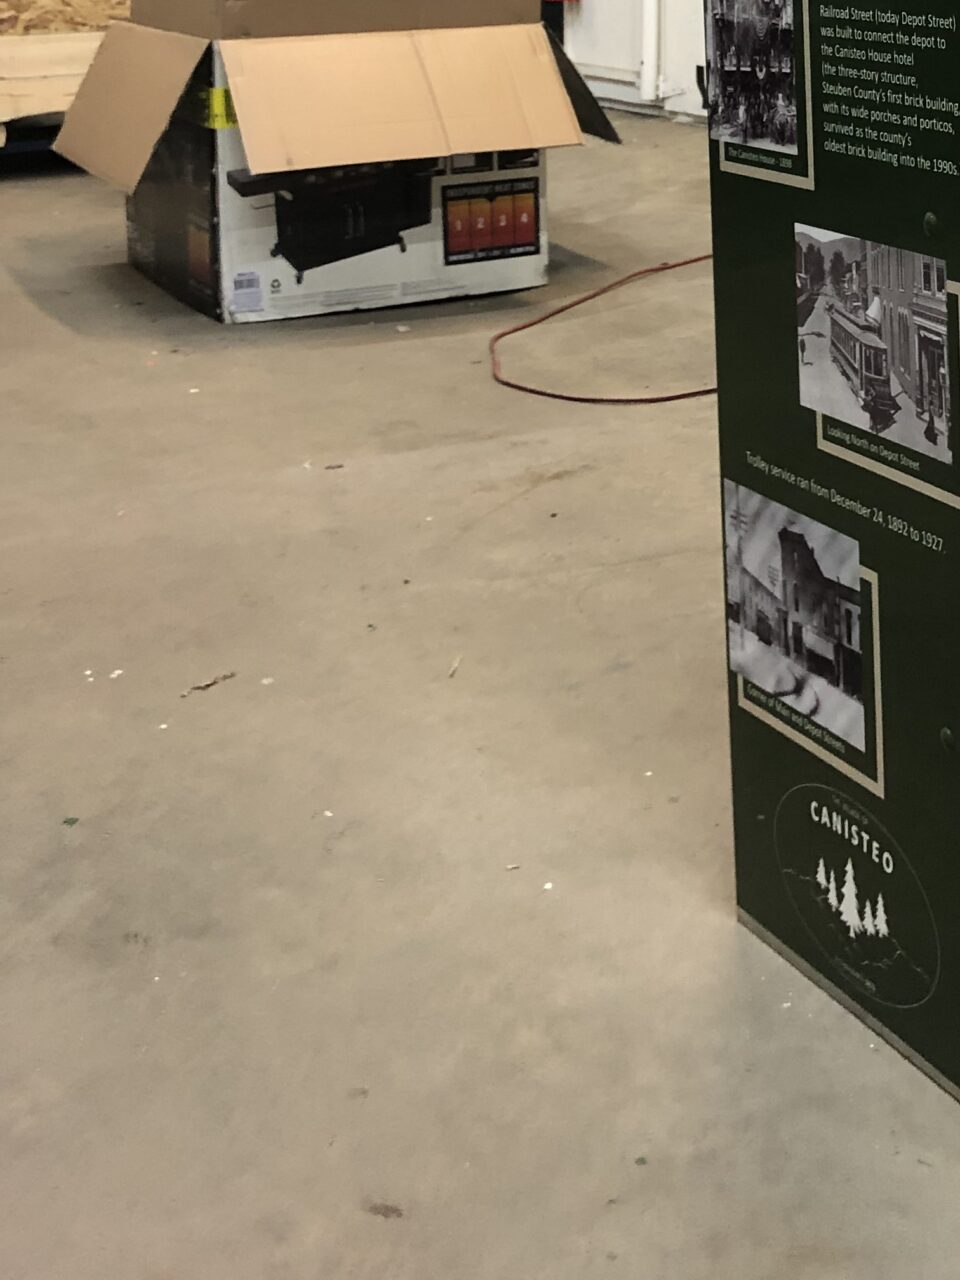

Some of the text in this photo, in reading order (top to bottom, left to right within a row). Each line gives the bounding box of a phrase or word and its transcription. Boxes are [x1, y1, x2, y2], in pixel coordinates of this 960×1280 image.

[820, 4, 956, 32] Railroad Street (today Depot Street)
[822, 81, 851, 96] Steuben
[887, 89, 903, 105] first
[904, 92, 924, 109] brick
[746, 450, 769, 474] Trolley
[770, 463, 796, 484] service
[797, 475, 809, 490] ran
[810, 478, 830, 499] from
[830, 488, 871, 519] December
[888, 515, 908, 537] 1892
[909, 527, 919, 542] to
[810, 800, 894, 874] CANISTEO
